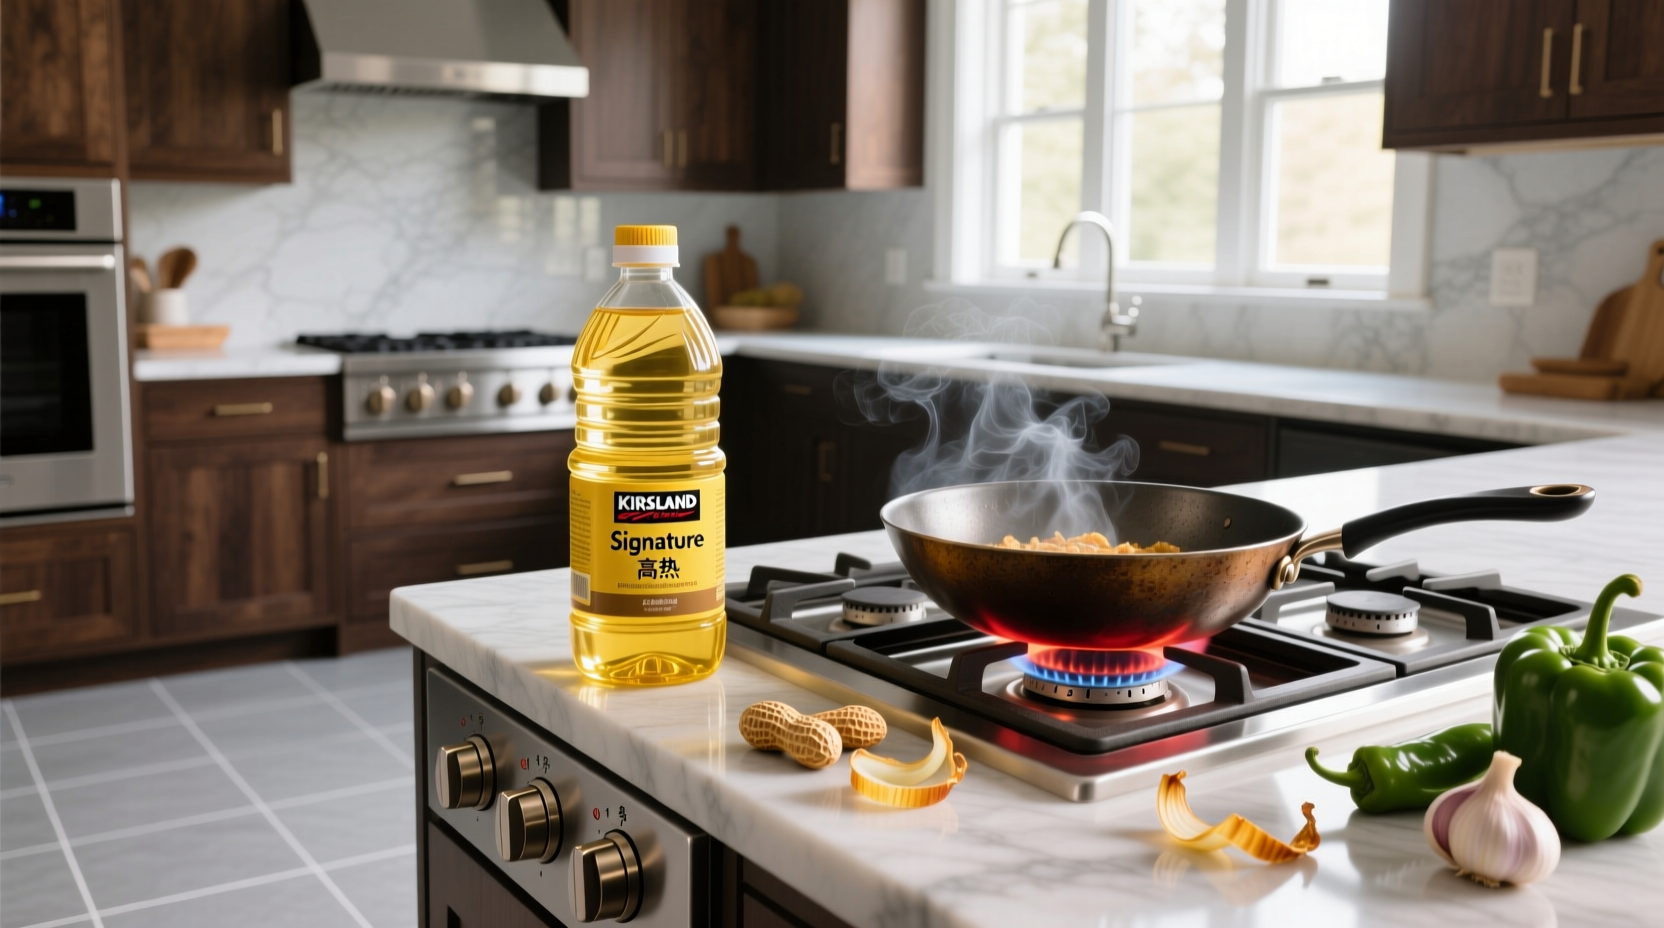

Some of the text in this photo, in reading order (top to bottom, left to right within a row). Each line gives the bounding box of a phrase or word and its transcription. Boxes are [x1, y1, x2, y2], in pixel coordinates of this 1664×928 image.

[618, 494, 697, 511] KIRSLAND
[611, 530, 704, 556] Signature
[638, 557, 680, 580] 高热
